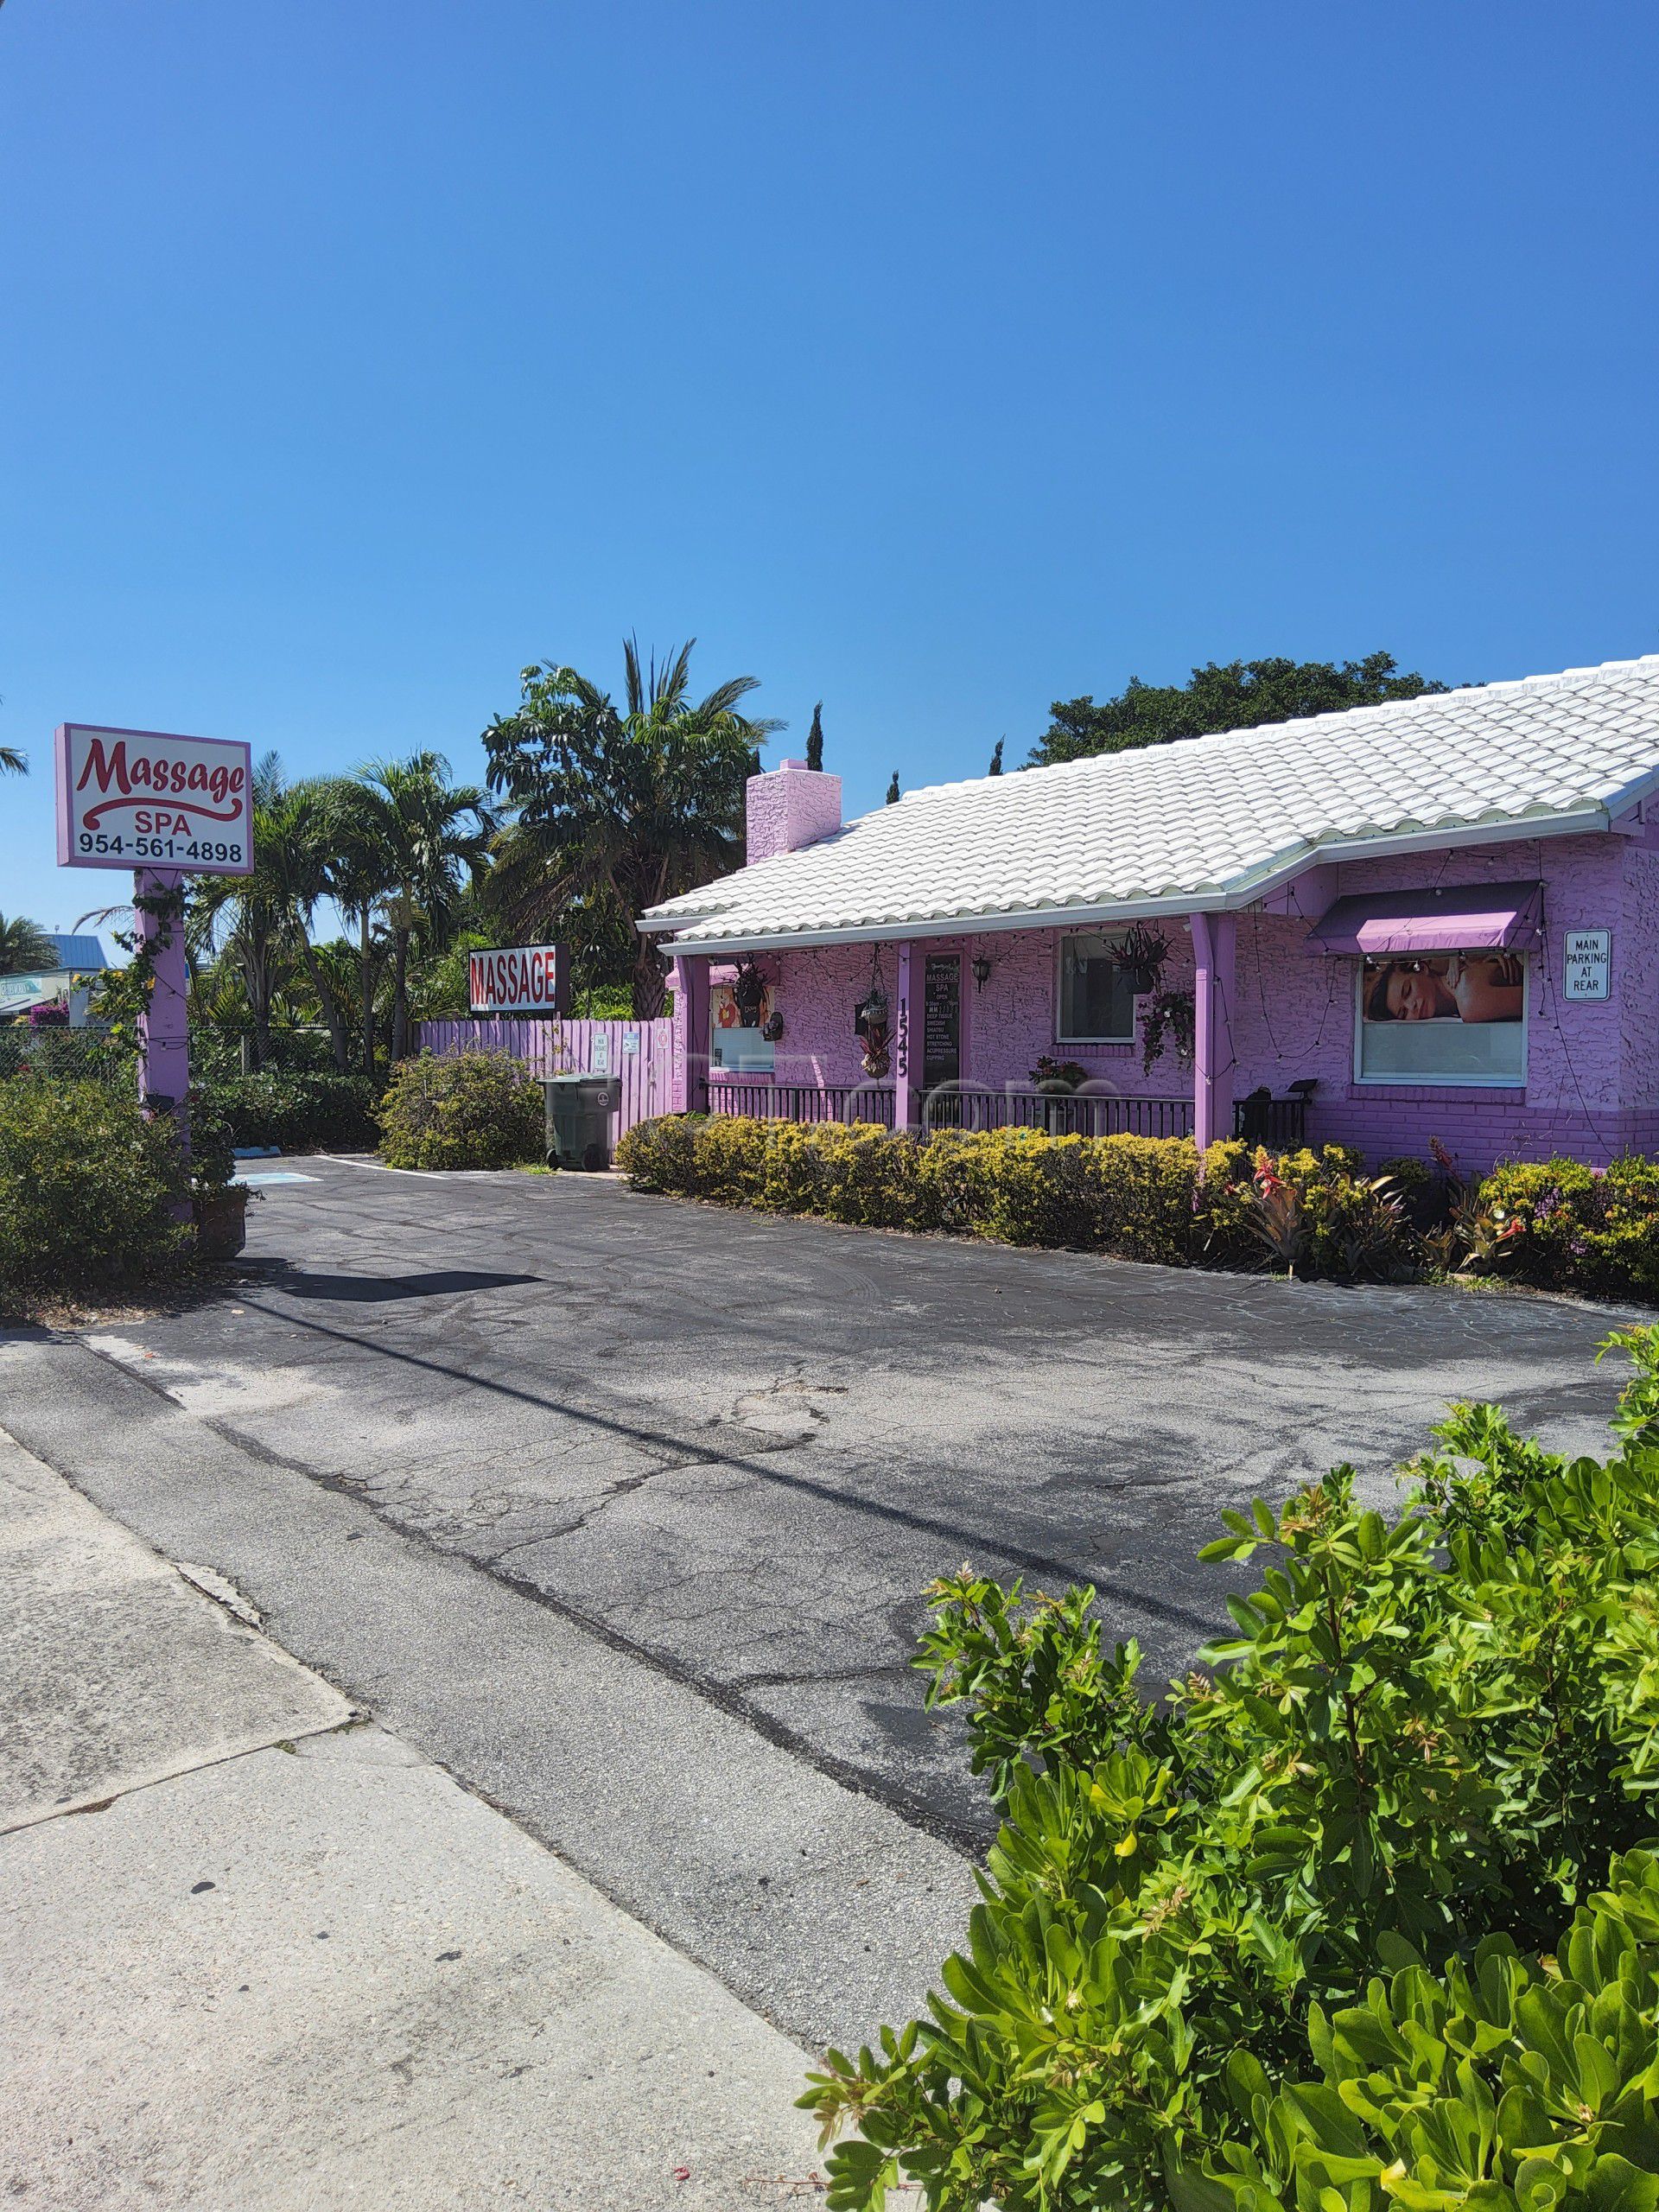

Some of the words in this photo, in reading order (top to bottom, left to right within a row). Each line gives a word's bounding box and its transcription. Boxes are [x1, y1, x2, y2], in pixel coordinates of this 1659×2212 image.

[76, 738, 245, 804] Massage
[134, 810, 192, 836] SPA
[79, 833, 243, 862] 954-561-4898
[1575, 939, 1599, 950] MAIN
[1567, 953, 1607, 964] PARKING
[926, 973, 959, 982] MASSAGE
[1580, 967, 1592, 977] AT
[470, 951, 556, 1005] MASSAGE
[935, 983, 949, 992] SPA
[1573, 980, 1599, 991] REAR
[898, 997, 908, 1077] 1545
